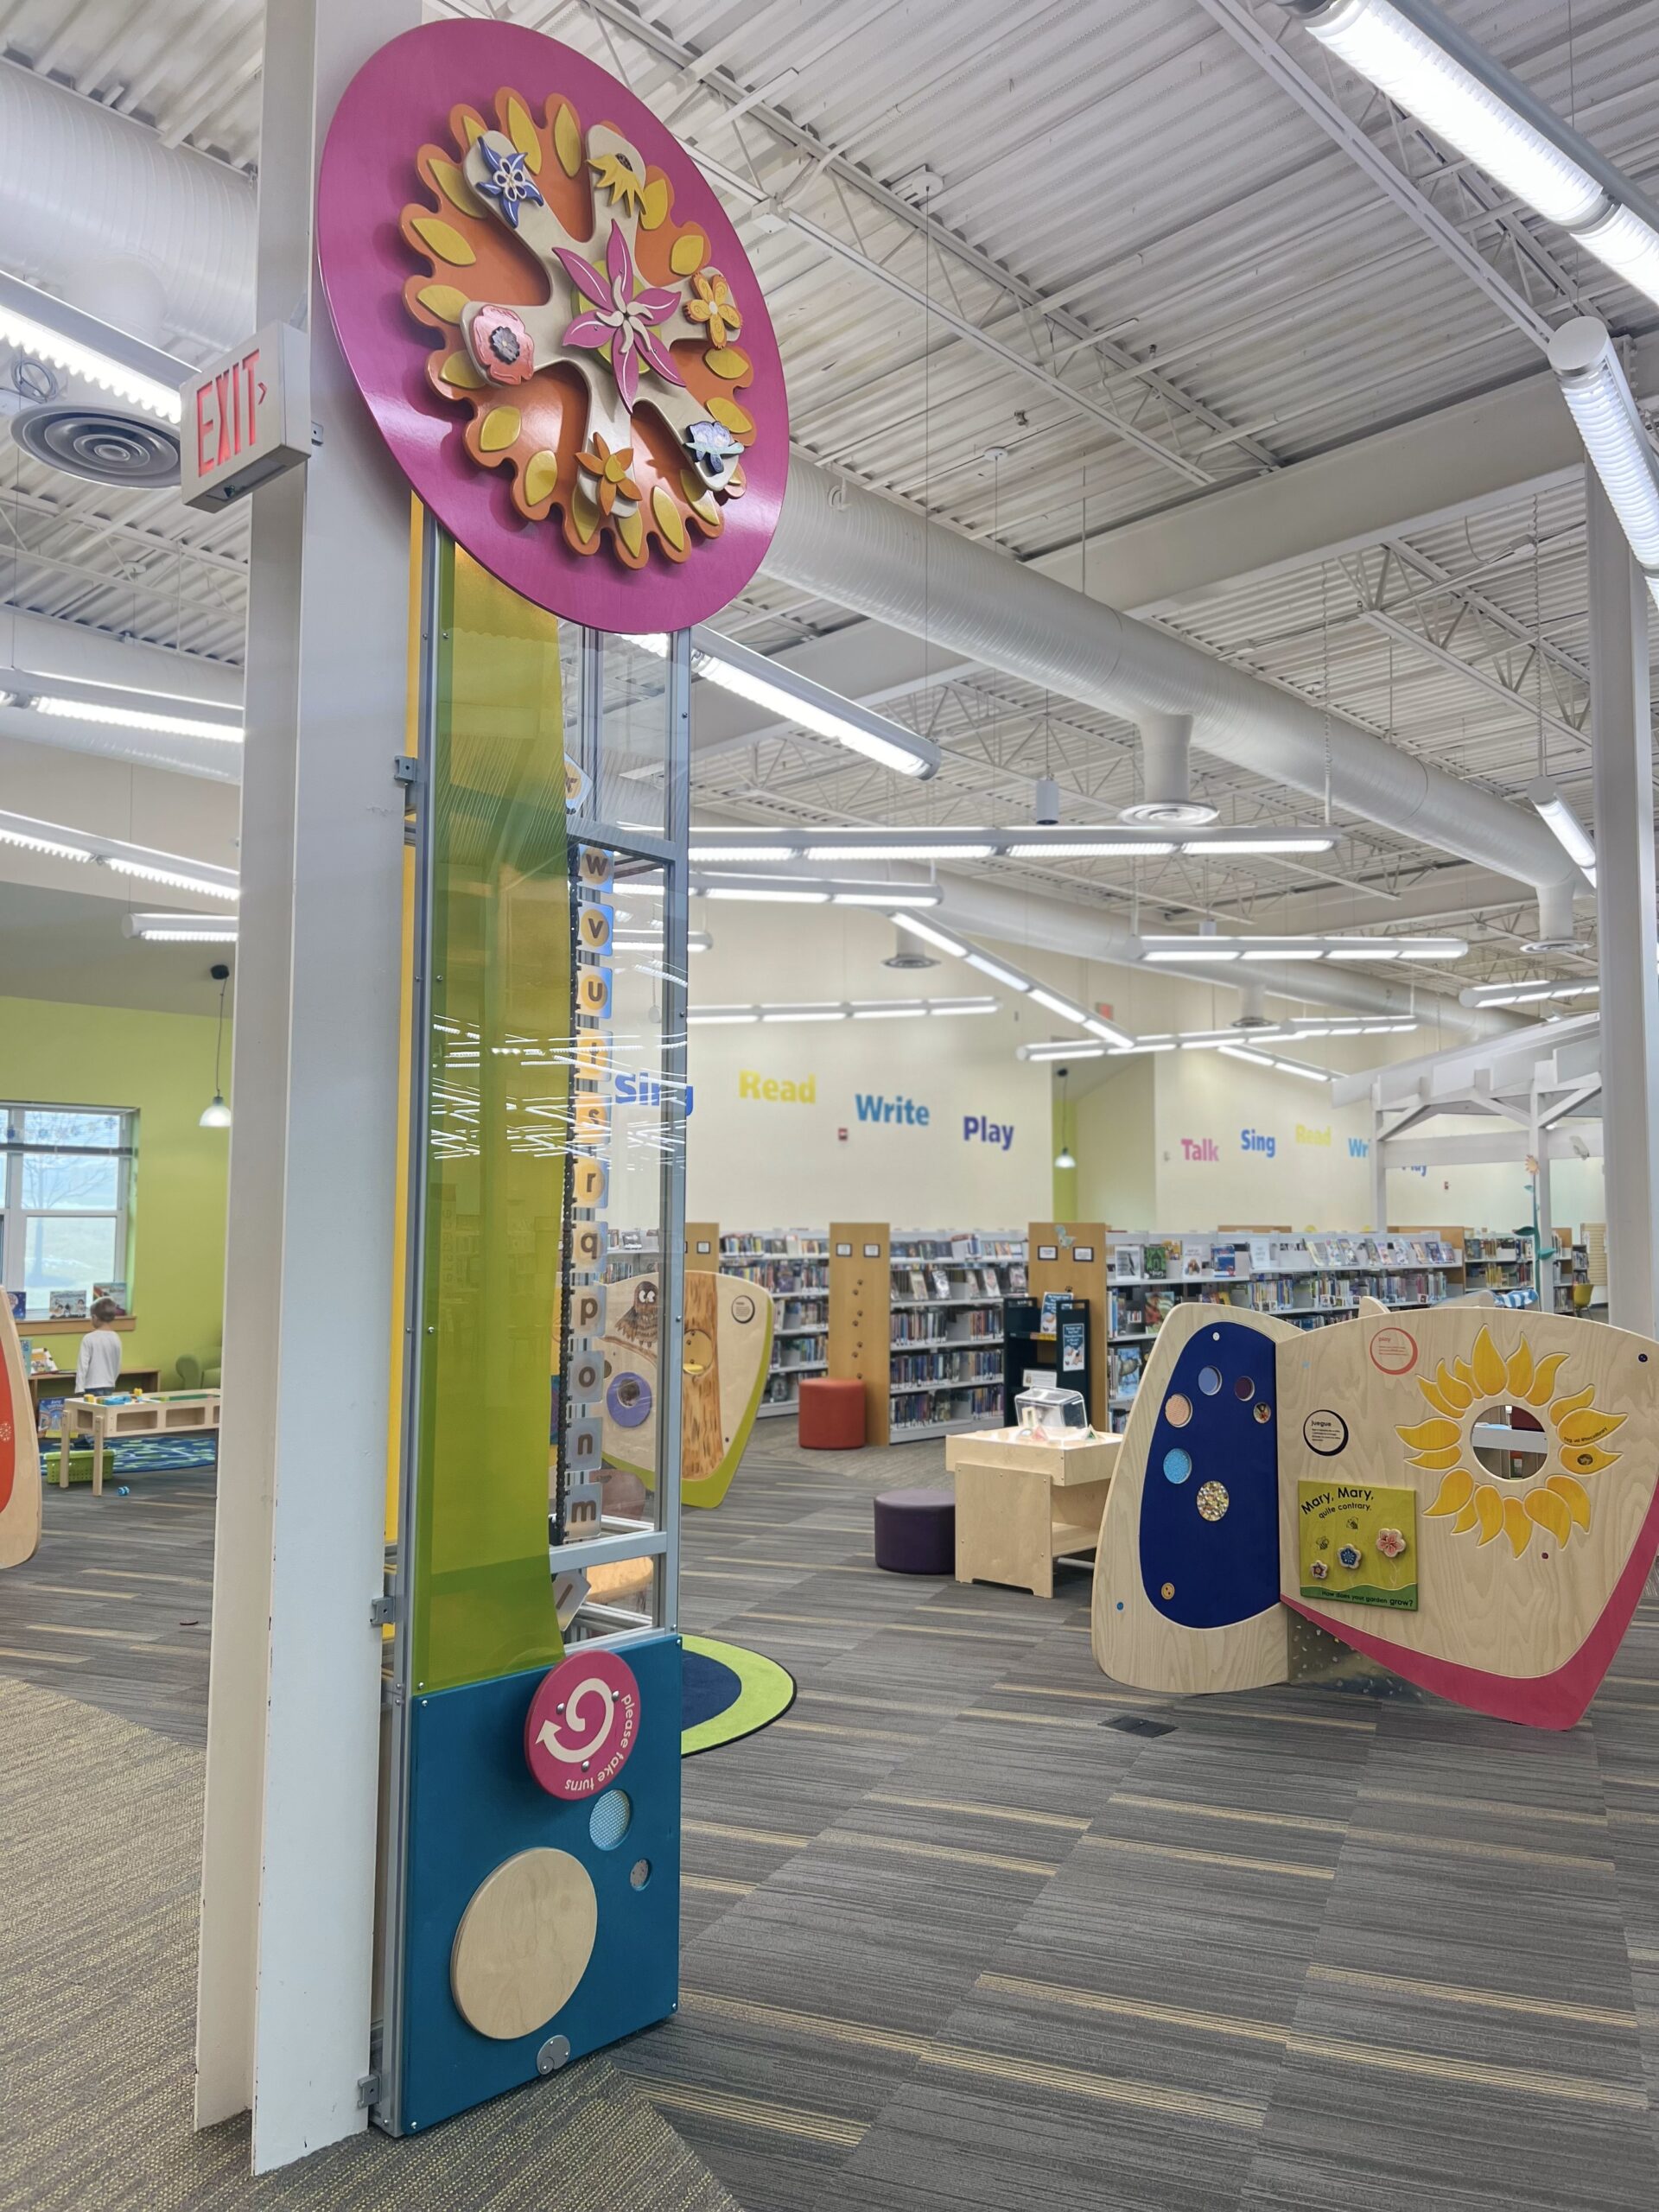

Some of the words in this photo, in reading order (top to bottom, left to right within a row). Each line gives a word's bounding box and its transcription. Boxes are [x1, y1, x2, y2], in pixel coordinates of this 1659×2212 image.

[196, 349, 259, 478] EXIT
[739, 1071, 816, 1104] Read
[855, 1094, 930, 1126] Write
[963, 1116, 1014, 1150] Play
[1180, 1139, 1219, 1162] Talk
[1241, 1129, 1275, 1158] Sing
[1296, 1125, 1332, 1147] Read
[571, 1500, 597, 1522] m
[1301, 1492, 1334, 1515] Mary,
[1338, 1487, 1374, 1500] Mary,
[1319, 1507, 1336, 1519] quite
[1389, 1598, 1414, 1607] grow?
[620, 1694, 635, 1748] please
[597, 1751, 624, 1782] take
[564, 1777, 594, 1791] turns
